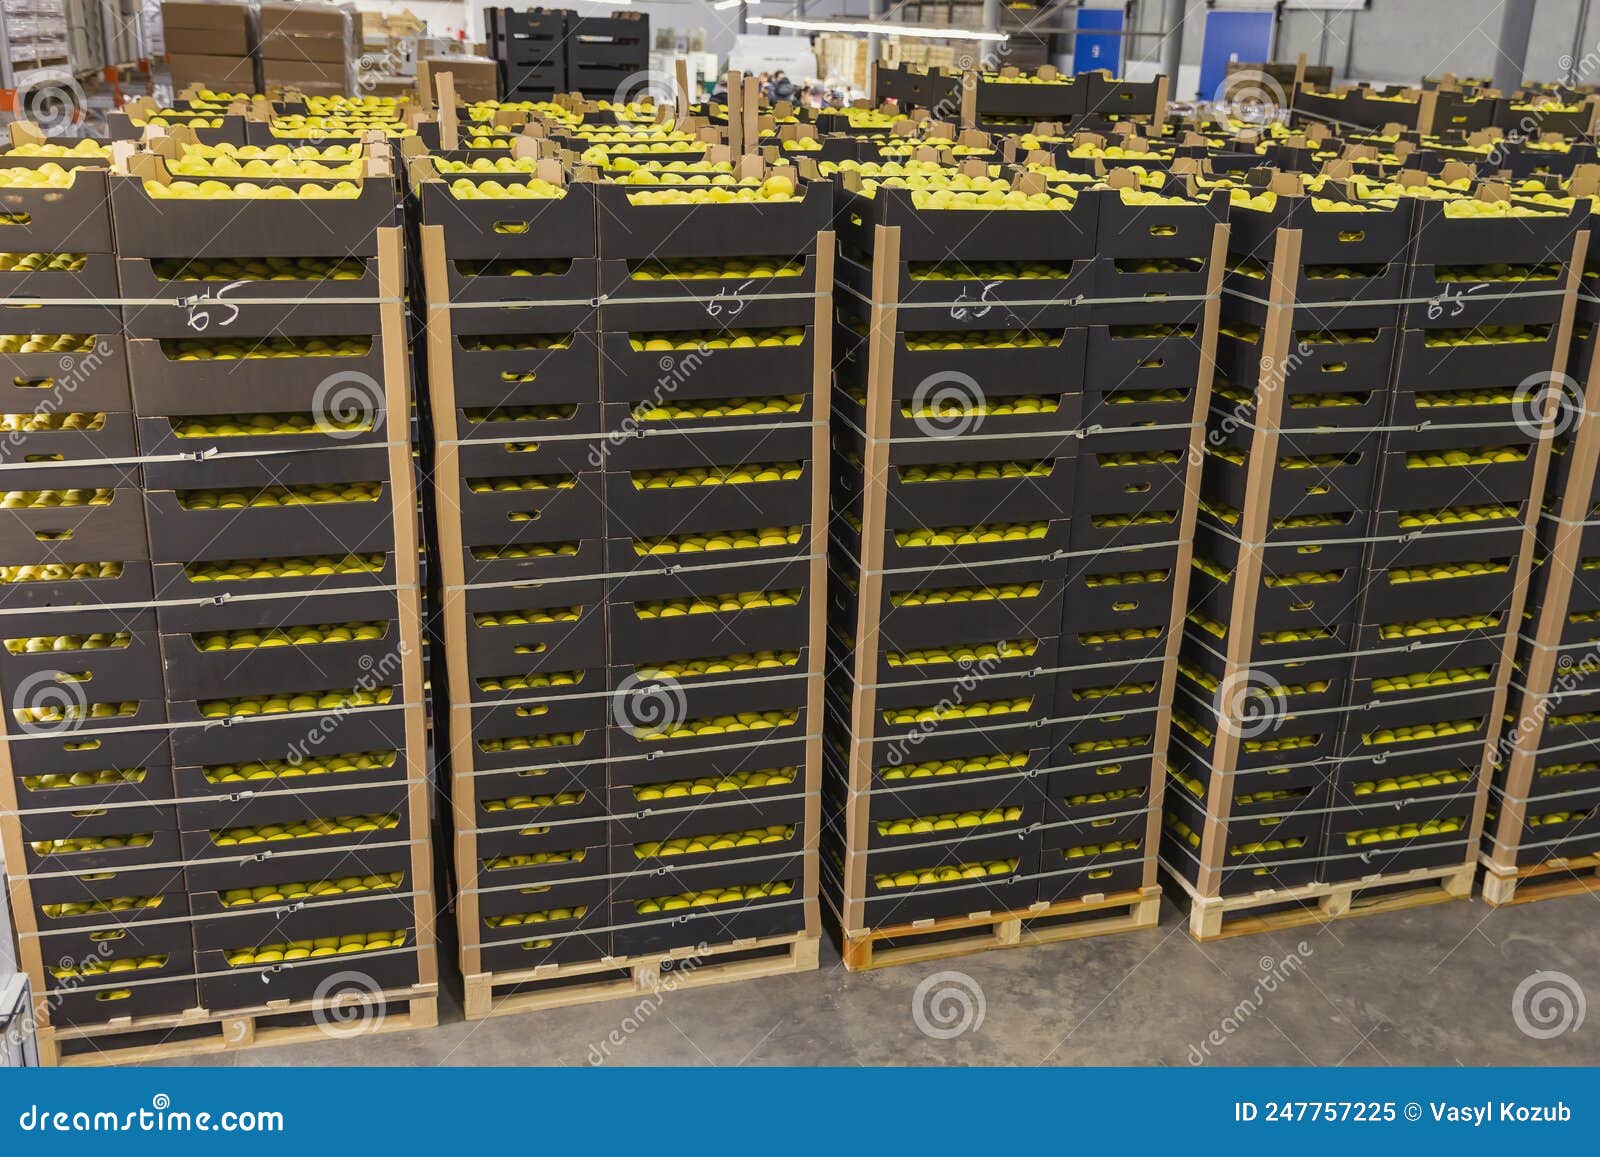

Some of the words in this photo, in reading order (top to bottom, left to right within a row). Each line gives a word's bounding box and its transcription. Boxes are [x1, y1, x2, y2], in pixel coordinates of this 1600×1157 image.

[187, 280, 254, 331] 65
[706, 279, 756, 316] 65
[950, 280, 1004, 320] 65
